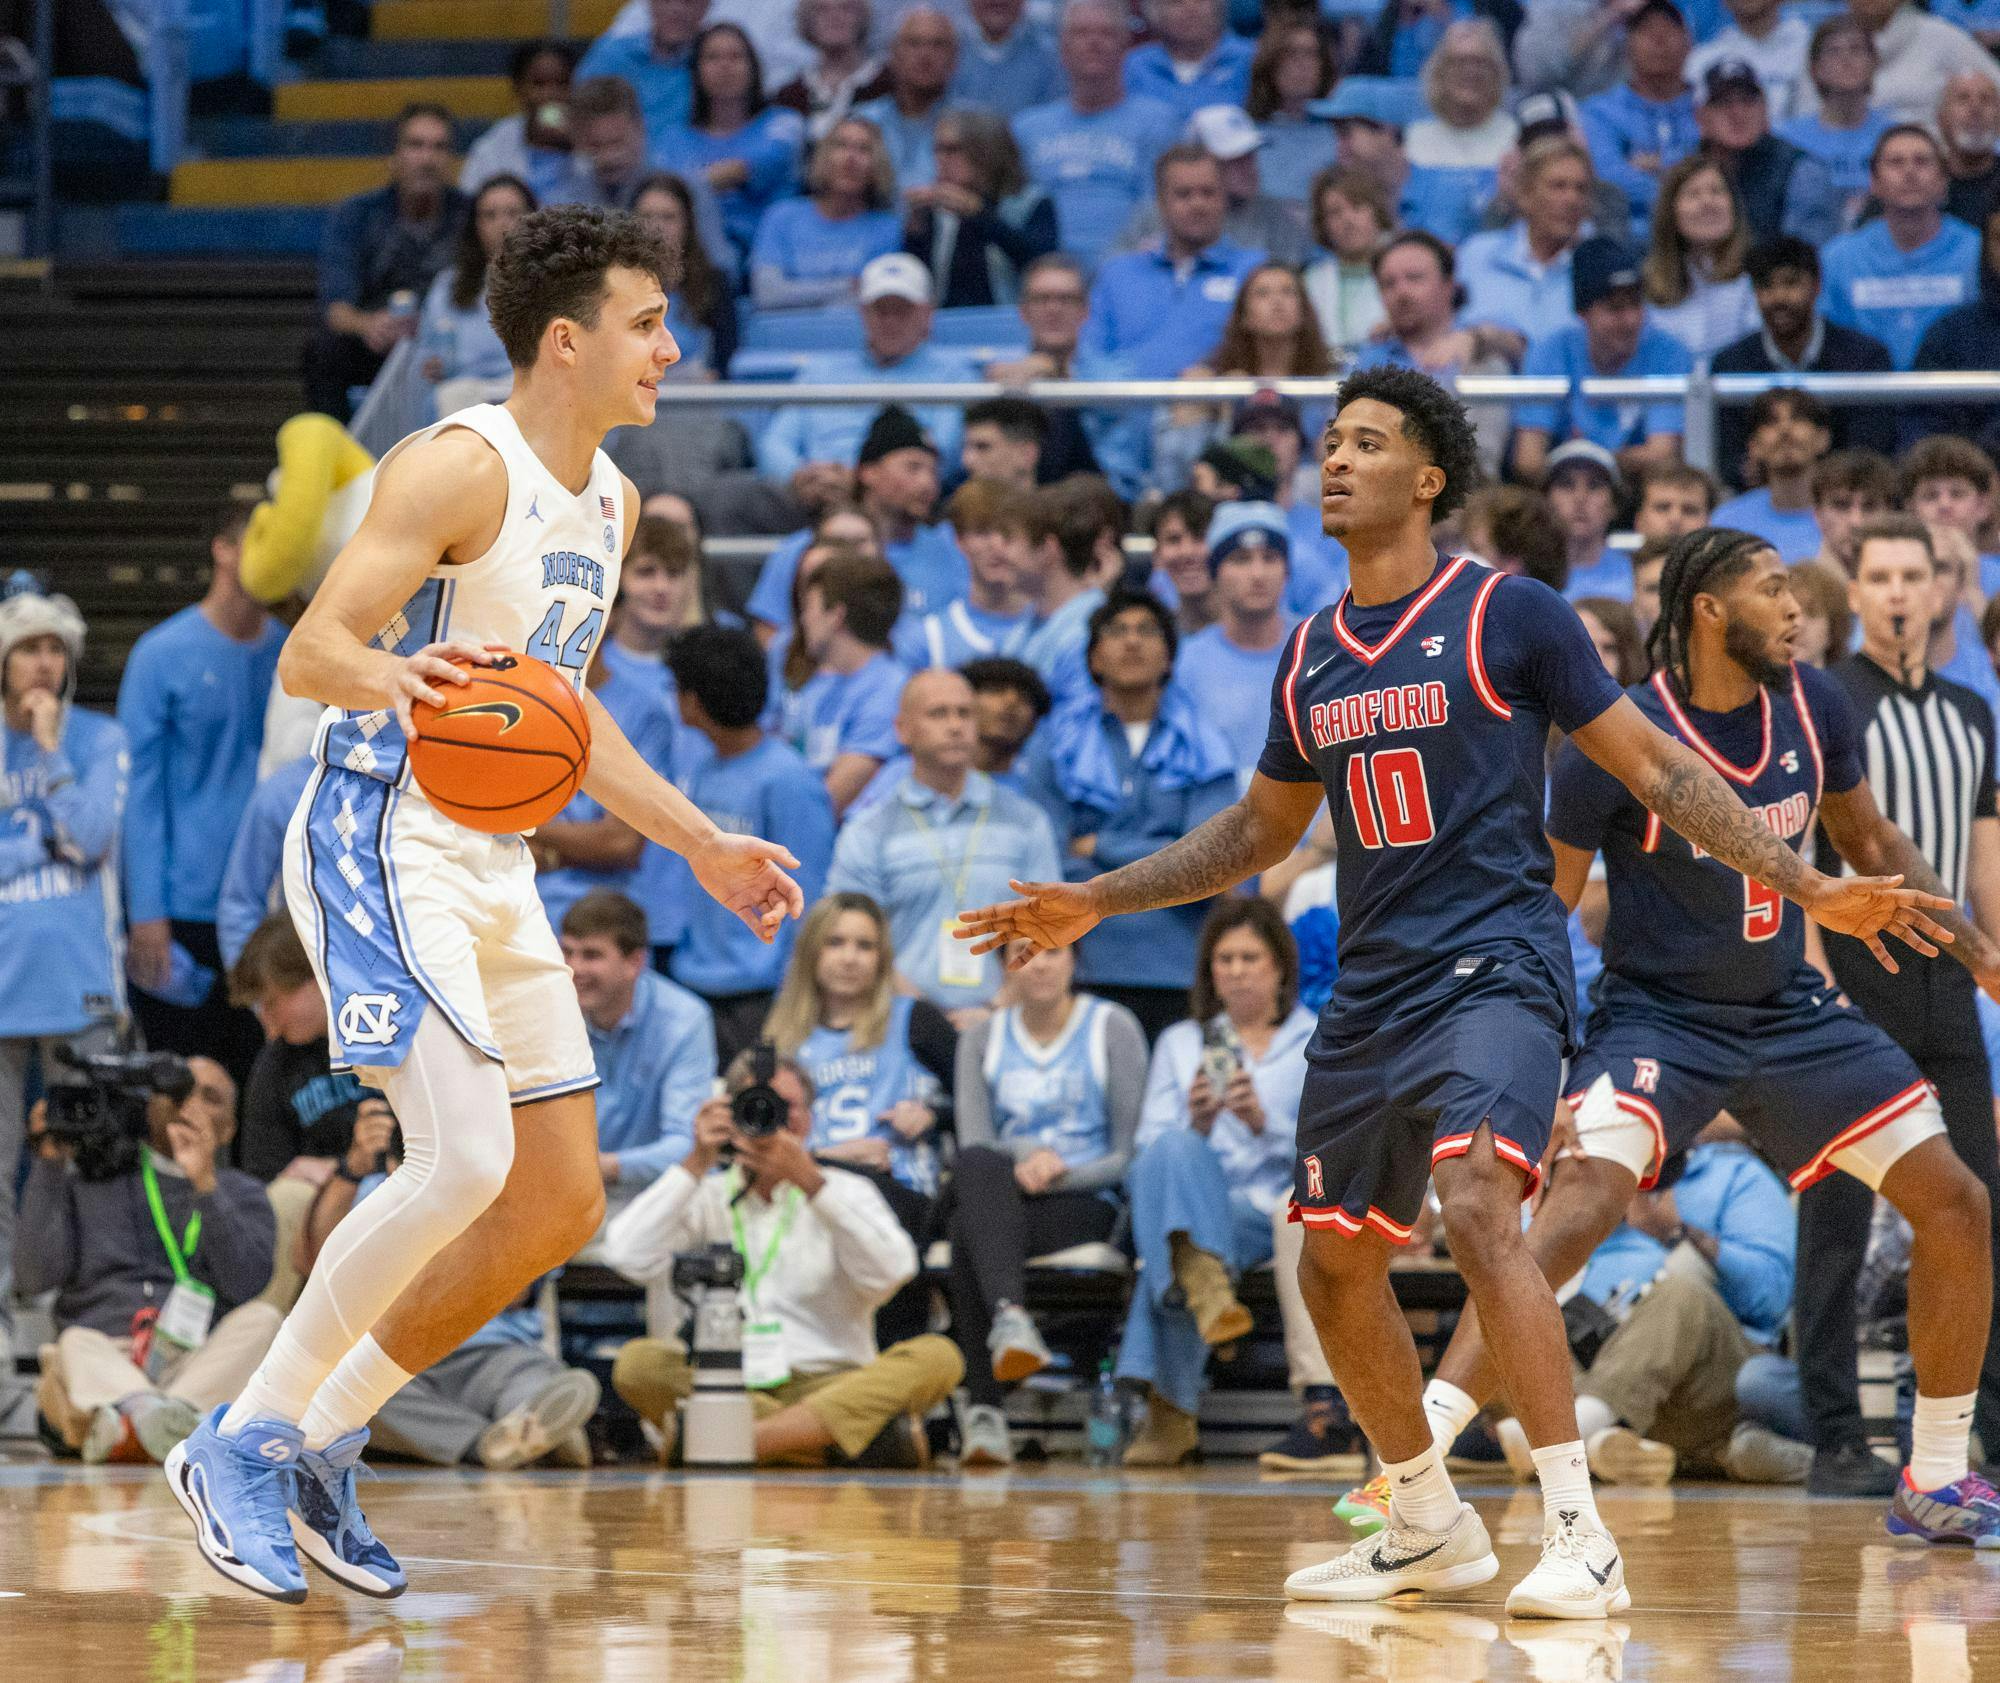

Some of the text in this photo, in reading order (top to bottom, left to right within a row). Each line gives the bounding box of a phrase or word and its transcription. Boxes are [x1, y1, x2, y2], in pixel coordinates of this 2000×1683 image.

[541, 551, 605, 600] NORTH
[526, 600, 604, 693] 44
[1310, 681, 1449, 749] RADFORD
[1346, 747, 1436, 849] 10
[1304, 1154, 1325, 1200] R
